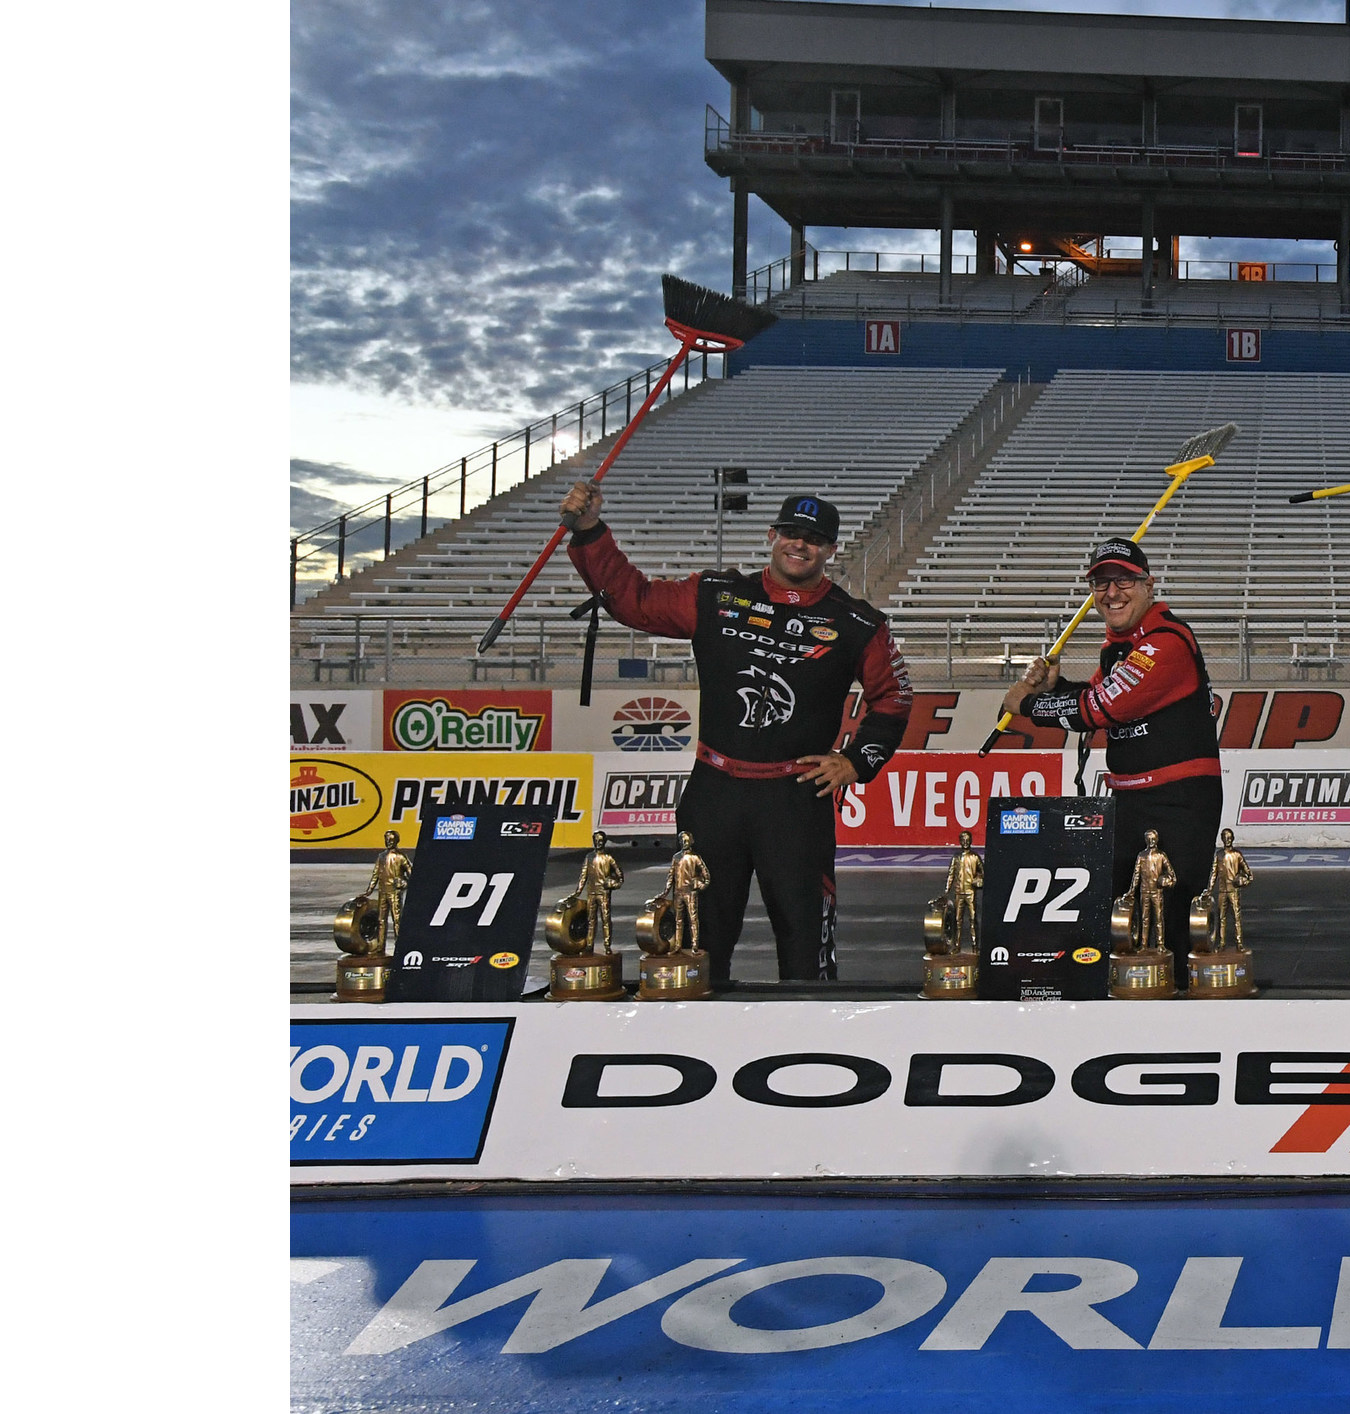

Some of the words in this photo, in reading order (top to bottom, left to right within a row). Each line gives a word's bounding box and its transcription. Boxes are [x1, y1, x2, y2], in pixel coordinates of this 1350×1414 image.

[869, 324, 895, 351] 1A
[1231, 331, 1257, 358] 1B
[722, 627, 815, 654] DODGE
[748, 648, 805, 665] SRT
[1056, 706, 1078, 716] Center
[399, 705, 534, 750] O'Reilly
[1109, 722, 1149, 740] Center
[628, 813, 677, 823] BATTER
[1002, 814, 1038, 822] CAMPING
[1267, 811, 1337, 821] BATTERIES
[437, 821, 474, 829] CAMPING
[437, 828, 473, 836] WORLD
[1002, 821, 1038, 830] WORLD
[429, 872, 515, 926] P1
[1003, 868, 1090, 922] P2
[1033, 989, 1062, 997] Anderson
[290, 1045, 483, 1104] ORLD
